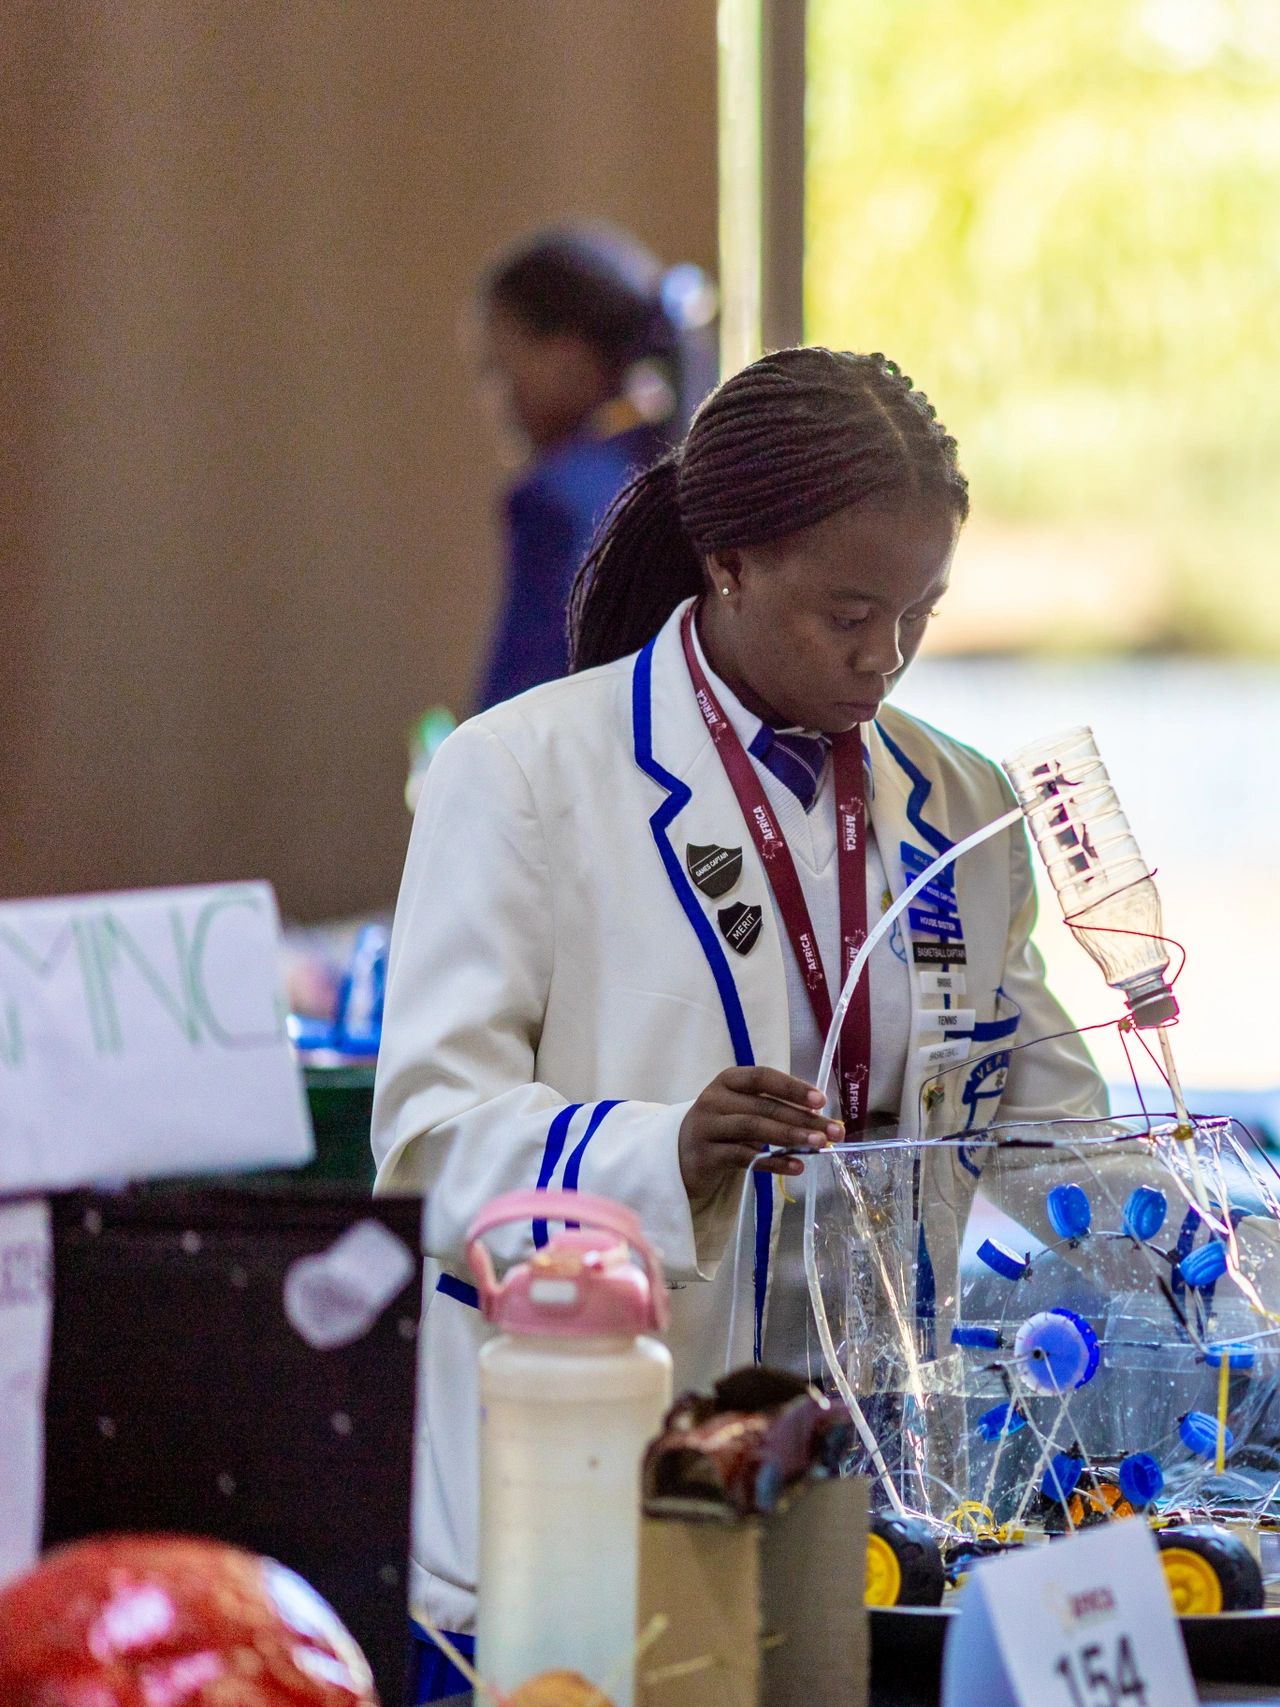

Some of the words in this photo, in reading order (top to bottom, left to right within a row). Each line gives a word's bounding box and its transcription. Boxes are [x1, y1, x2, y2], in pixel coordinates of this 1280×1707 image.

[695, 863, 711, 877] GAMES
[710, 851, 729, 868] CAPTAIN
[732, 913, 755, 940] MERIT
[938, 1015, 957, 1025] TENNIS
[1054, 1633, 1148, 1707] 154
